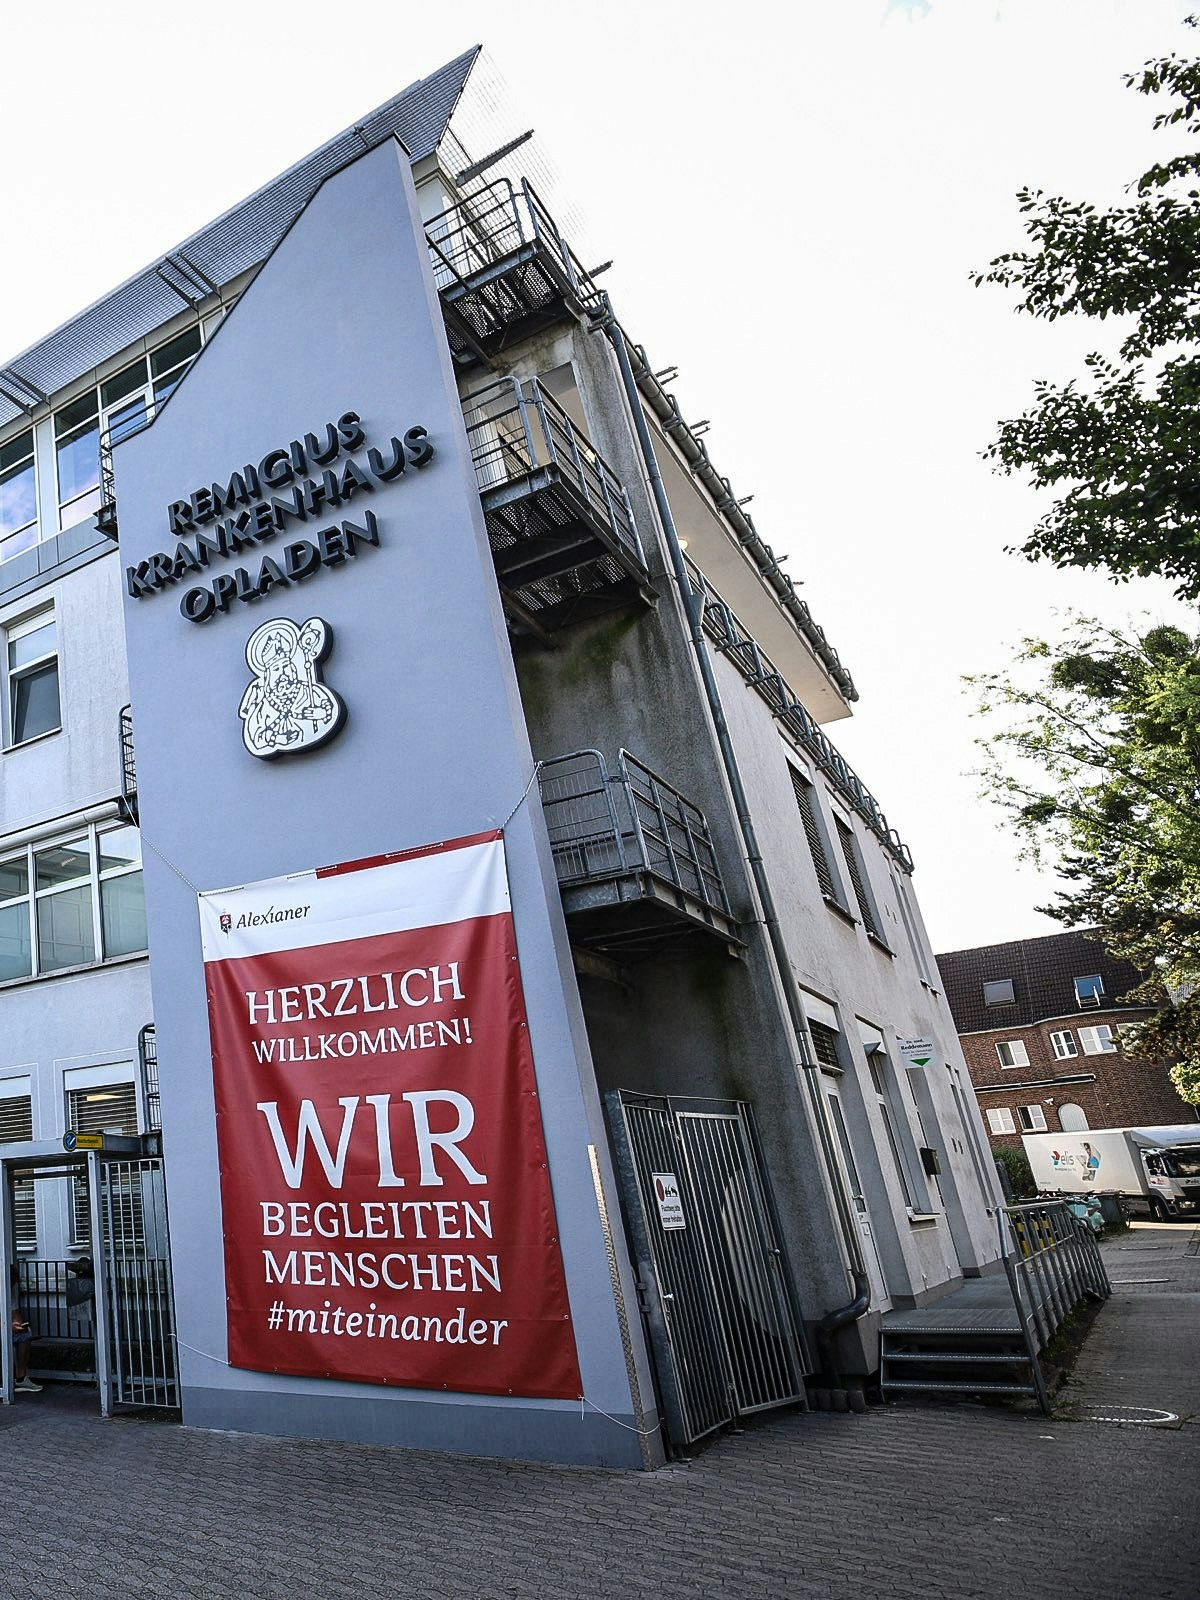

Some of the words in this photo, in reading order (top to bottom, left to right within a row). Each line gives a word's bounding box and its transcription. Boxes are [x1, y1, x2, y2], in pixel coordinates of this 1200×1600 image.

[167, 411, 366, 536] REMIGIUS
[126, 425, 435, 599] KRANKENHAUS
[180, 510, 380, 623] OPLADEN
[236, 905, 311, 929] Alexianer
[246, 961, 466, 1025] HERZLICH
[252, 1017, 474, 1064] WILLKOMMEN!
[256, 1089, 488, 1189] WIR
[259, 1200, 493, 1239] BEGLEITEN
[262, 1250, 502, 1293] MENSCHEN
[267, 1300, 509, 1345] #miteinander
